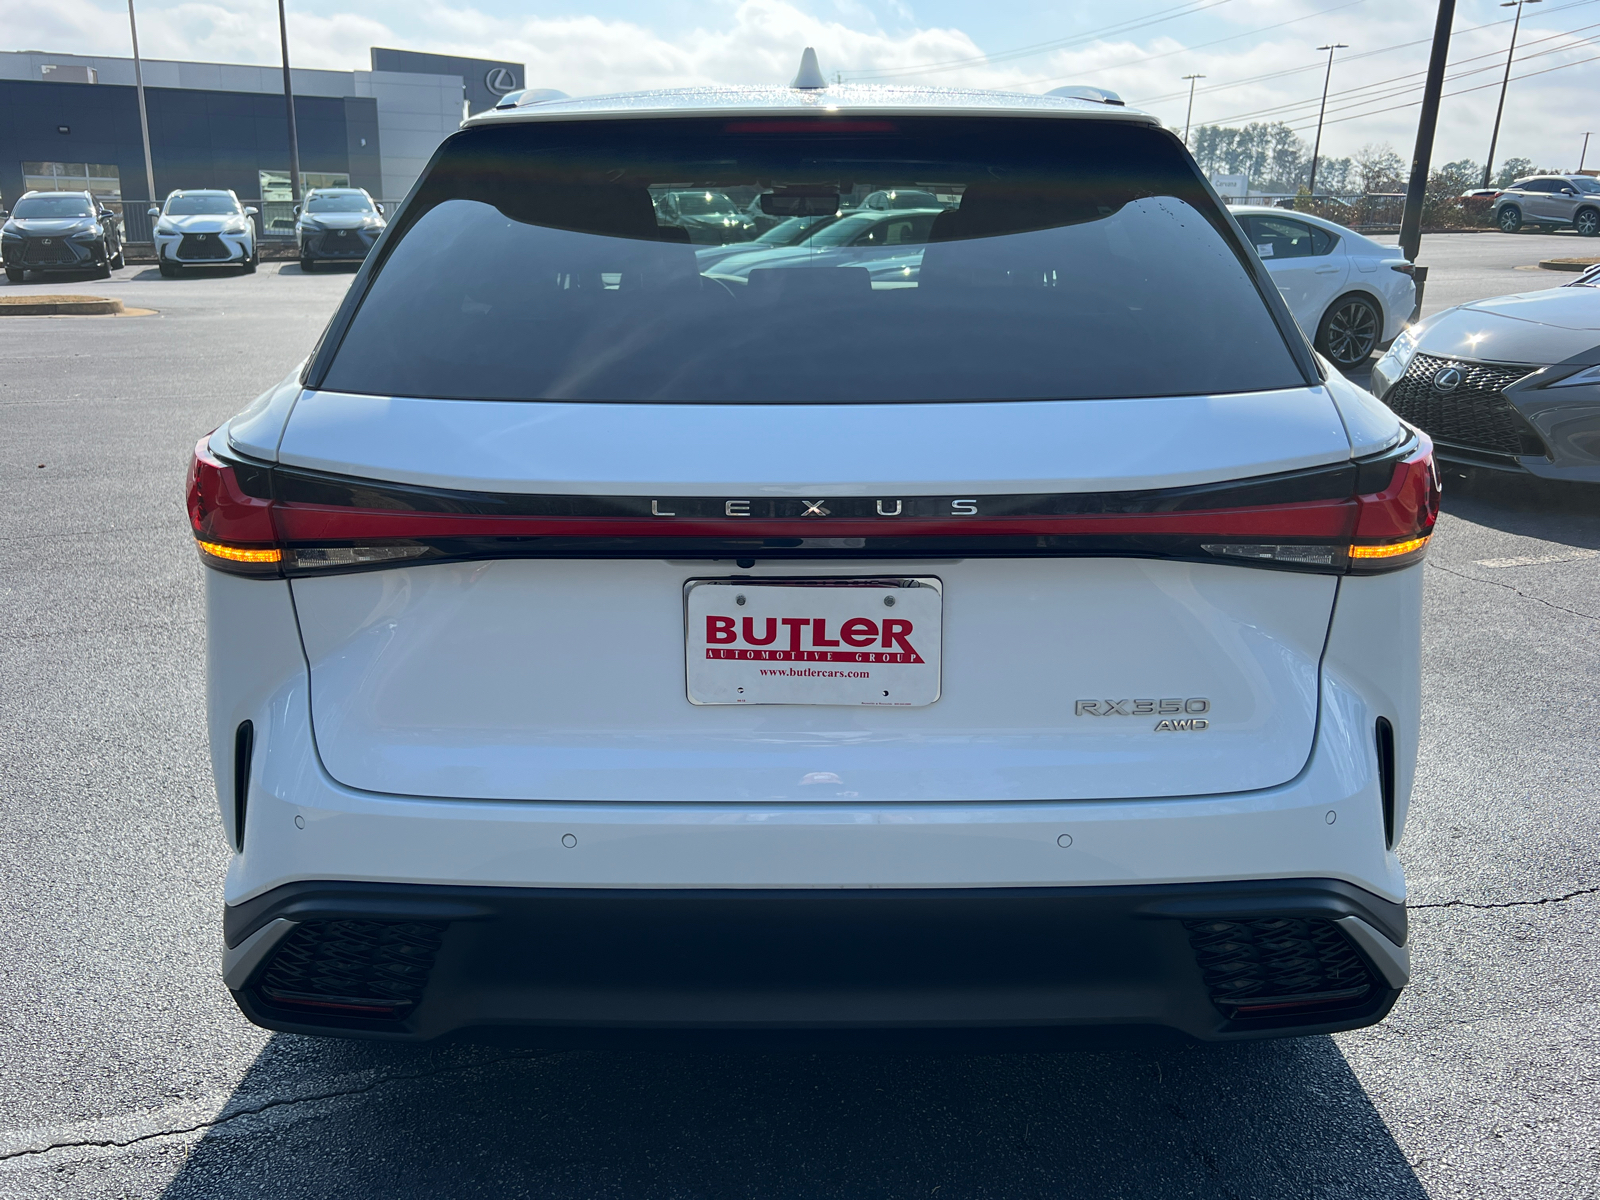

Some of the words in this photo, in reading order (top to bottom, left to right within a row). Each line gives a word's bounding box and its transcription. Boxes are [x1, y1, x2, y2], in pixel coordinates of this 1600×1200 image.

[651, 499, 978, 517] LEXUS
[707, 650, 834, 662] AUTOMOTIVE
[855, 652, 917, 663] GROUP
[760, 667, 870, 679] www.butlercars.com
[1075, 697, 1210, 716] RX350
[1154, 718, 1209, 732] AWD
